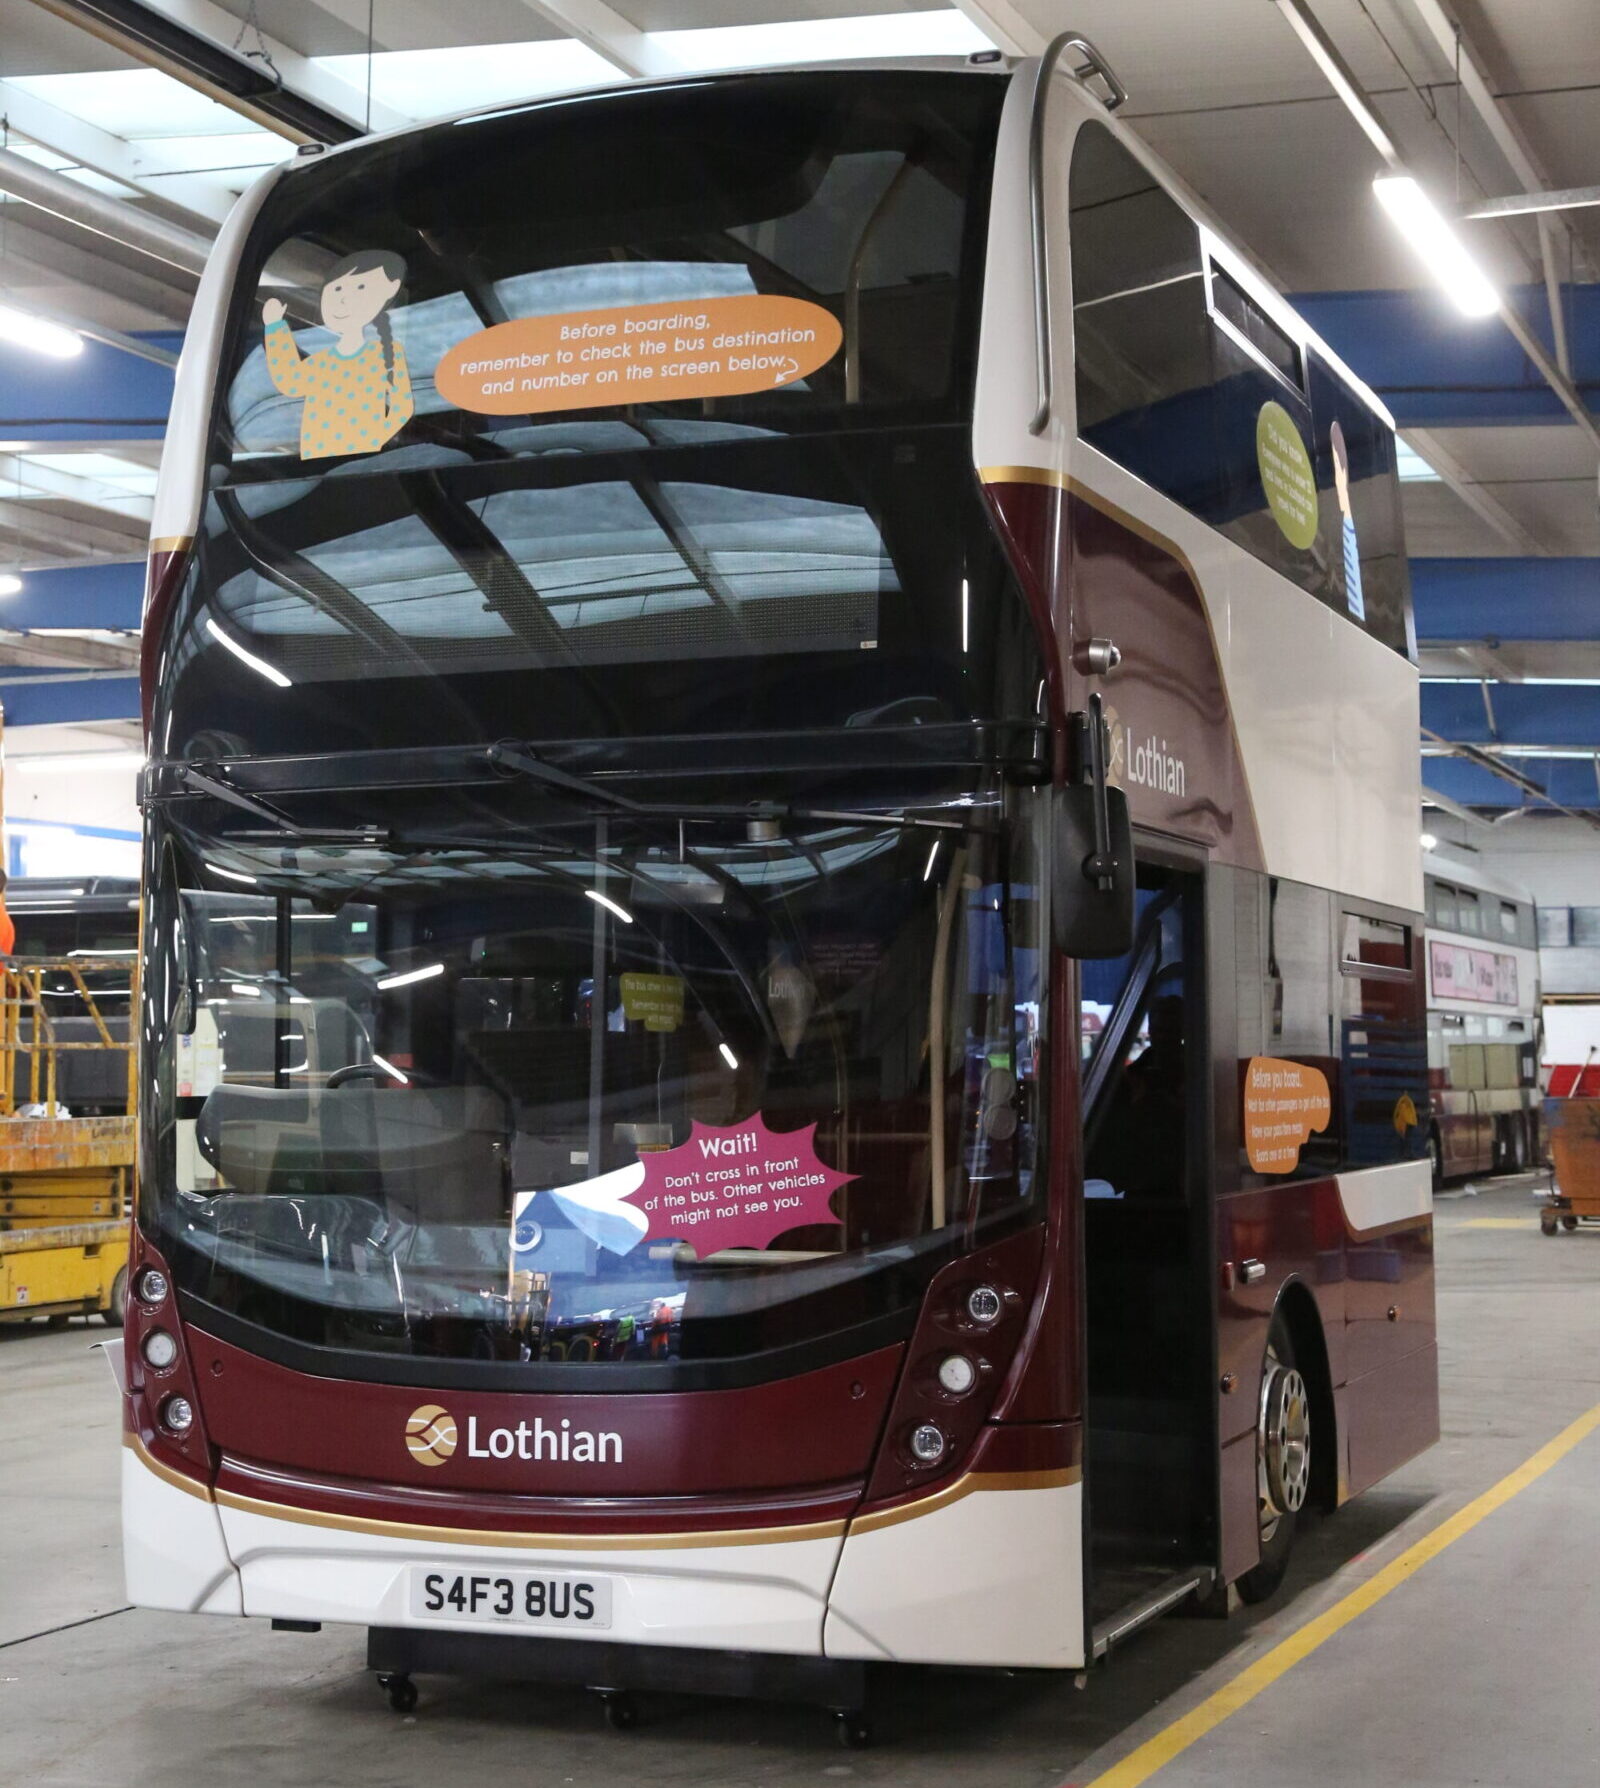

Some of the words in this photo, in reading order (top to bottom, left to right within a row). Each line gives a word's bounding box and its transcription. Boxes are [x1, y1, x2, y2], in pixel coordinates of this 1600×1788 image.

[560, 323, 616, 341] Before
[623, 313, 711, 334] boarding,
[459, 352, 549, 376] remember
[556, 350, 574, 365] to
[580, 342, 632, 361] check
[638, 340, 667, 356] the
[674, 337, 705, 353] bus
[712, 328, 816, 349] destination
[481, 378, 514, 395] and
[521, 371, 589, 391] number
[596, 369, 618, 384] on
[626, 364, 653, 380] the
[660, 360, 720, 378] screen
[728, 354, 787, 372] below.
[1126, 727, 1185, 798] Lothian
[698, 1132, 757, 1159] Wait!
[644, 1196, 659, 1210] of
[663, 1193, 686, 1208] the
[690, 1190, 719, 1204] bus.
[723, 1183, 763, 1199] Other
[768, 1173, 826, 1192] vehicles
[665, 1172, 700, 1188] Don't
[705, 1168, 741, 1183] cross
[745, 1164, 760, 1176] in
[764, 1156, 799, 1174] front
[671, 1207, 711, 1226] might
[716, 1203, 739, 1218] not
[744, 1200, 769, 1214] see
[773, 1195, 803, 1213] you.
[467, 1415, 624, 1464] Lothian
[425, 1574, 515, 1615] S4F3
[525, 1580, 595, 1620] 8US
